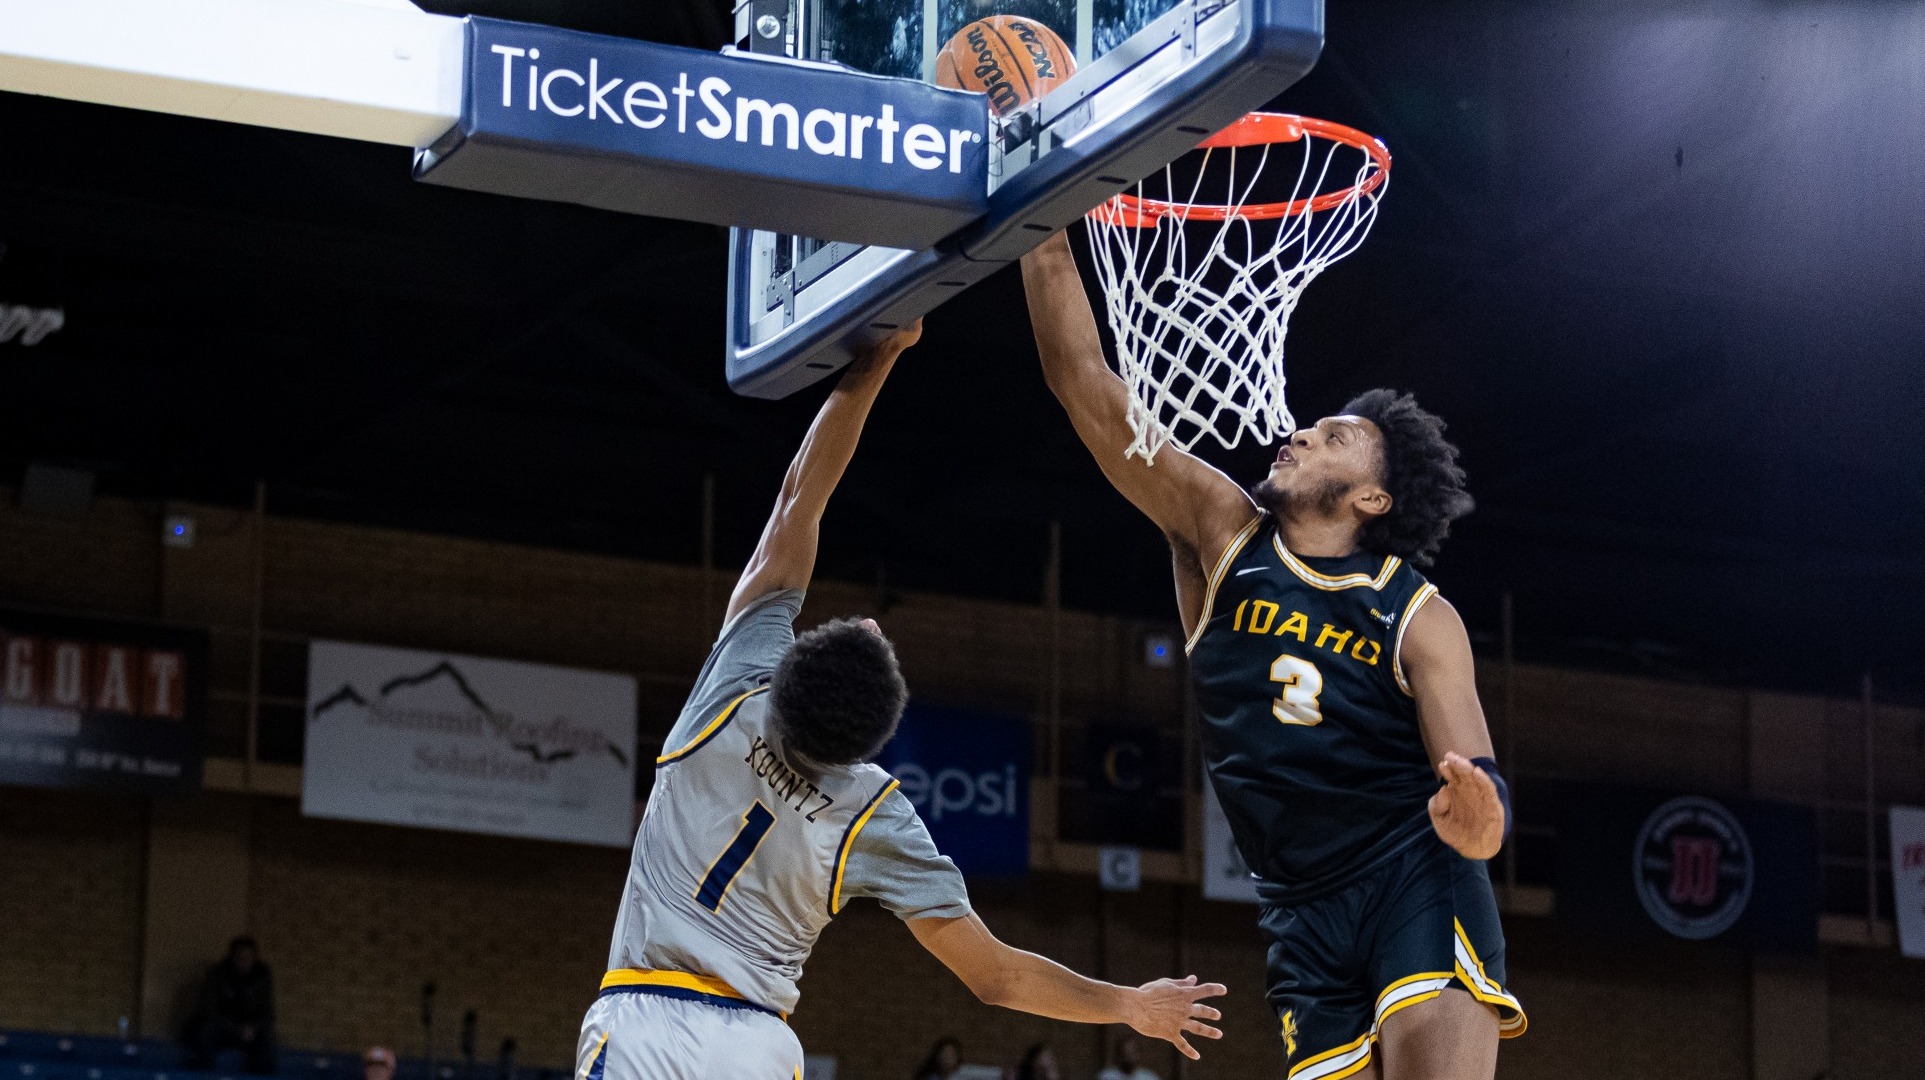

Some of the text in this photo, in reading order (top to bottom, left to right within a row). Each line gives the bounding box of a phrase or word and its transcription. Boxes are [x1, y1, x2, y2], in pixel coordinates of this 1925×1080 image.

[966, 26, 1021, 115] Wilson
[1008, 22, 1055, 78] NCAA
[1233, 599, 1381, 666] IDAHO
[6, 638, 180, 715] GOAT
[1270, 653, 1323, 726] 3
[744, 736, 834, 824] KOUNTZ
[892, 762, 1016, 821] epsi
[693, 799, 777, 915] 1
